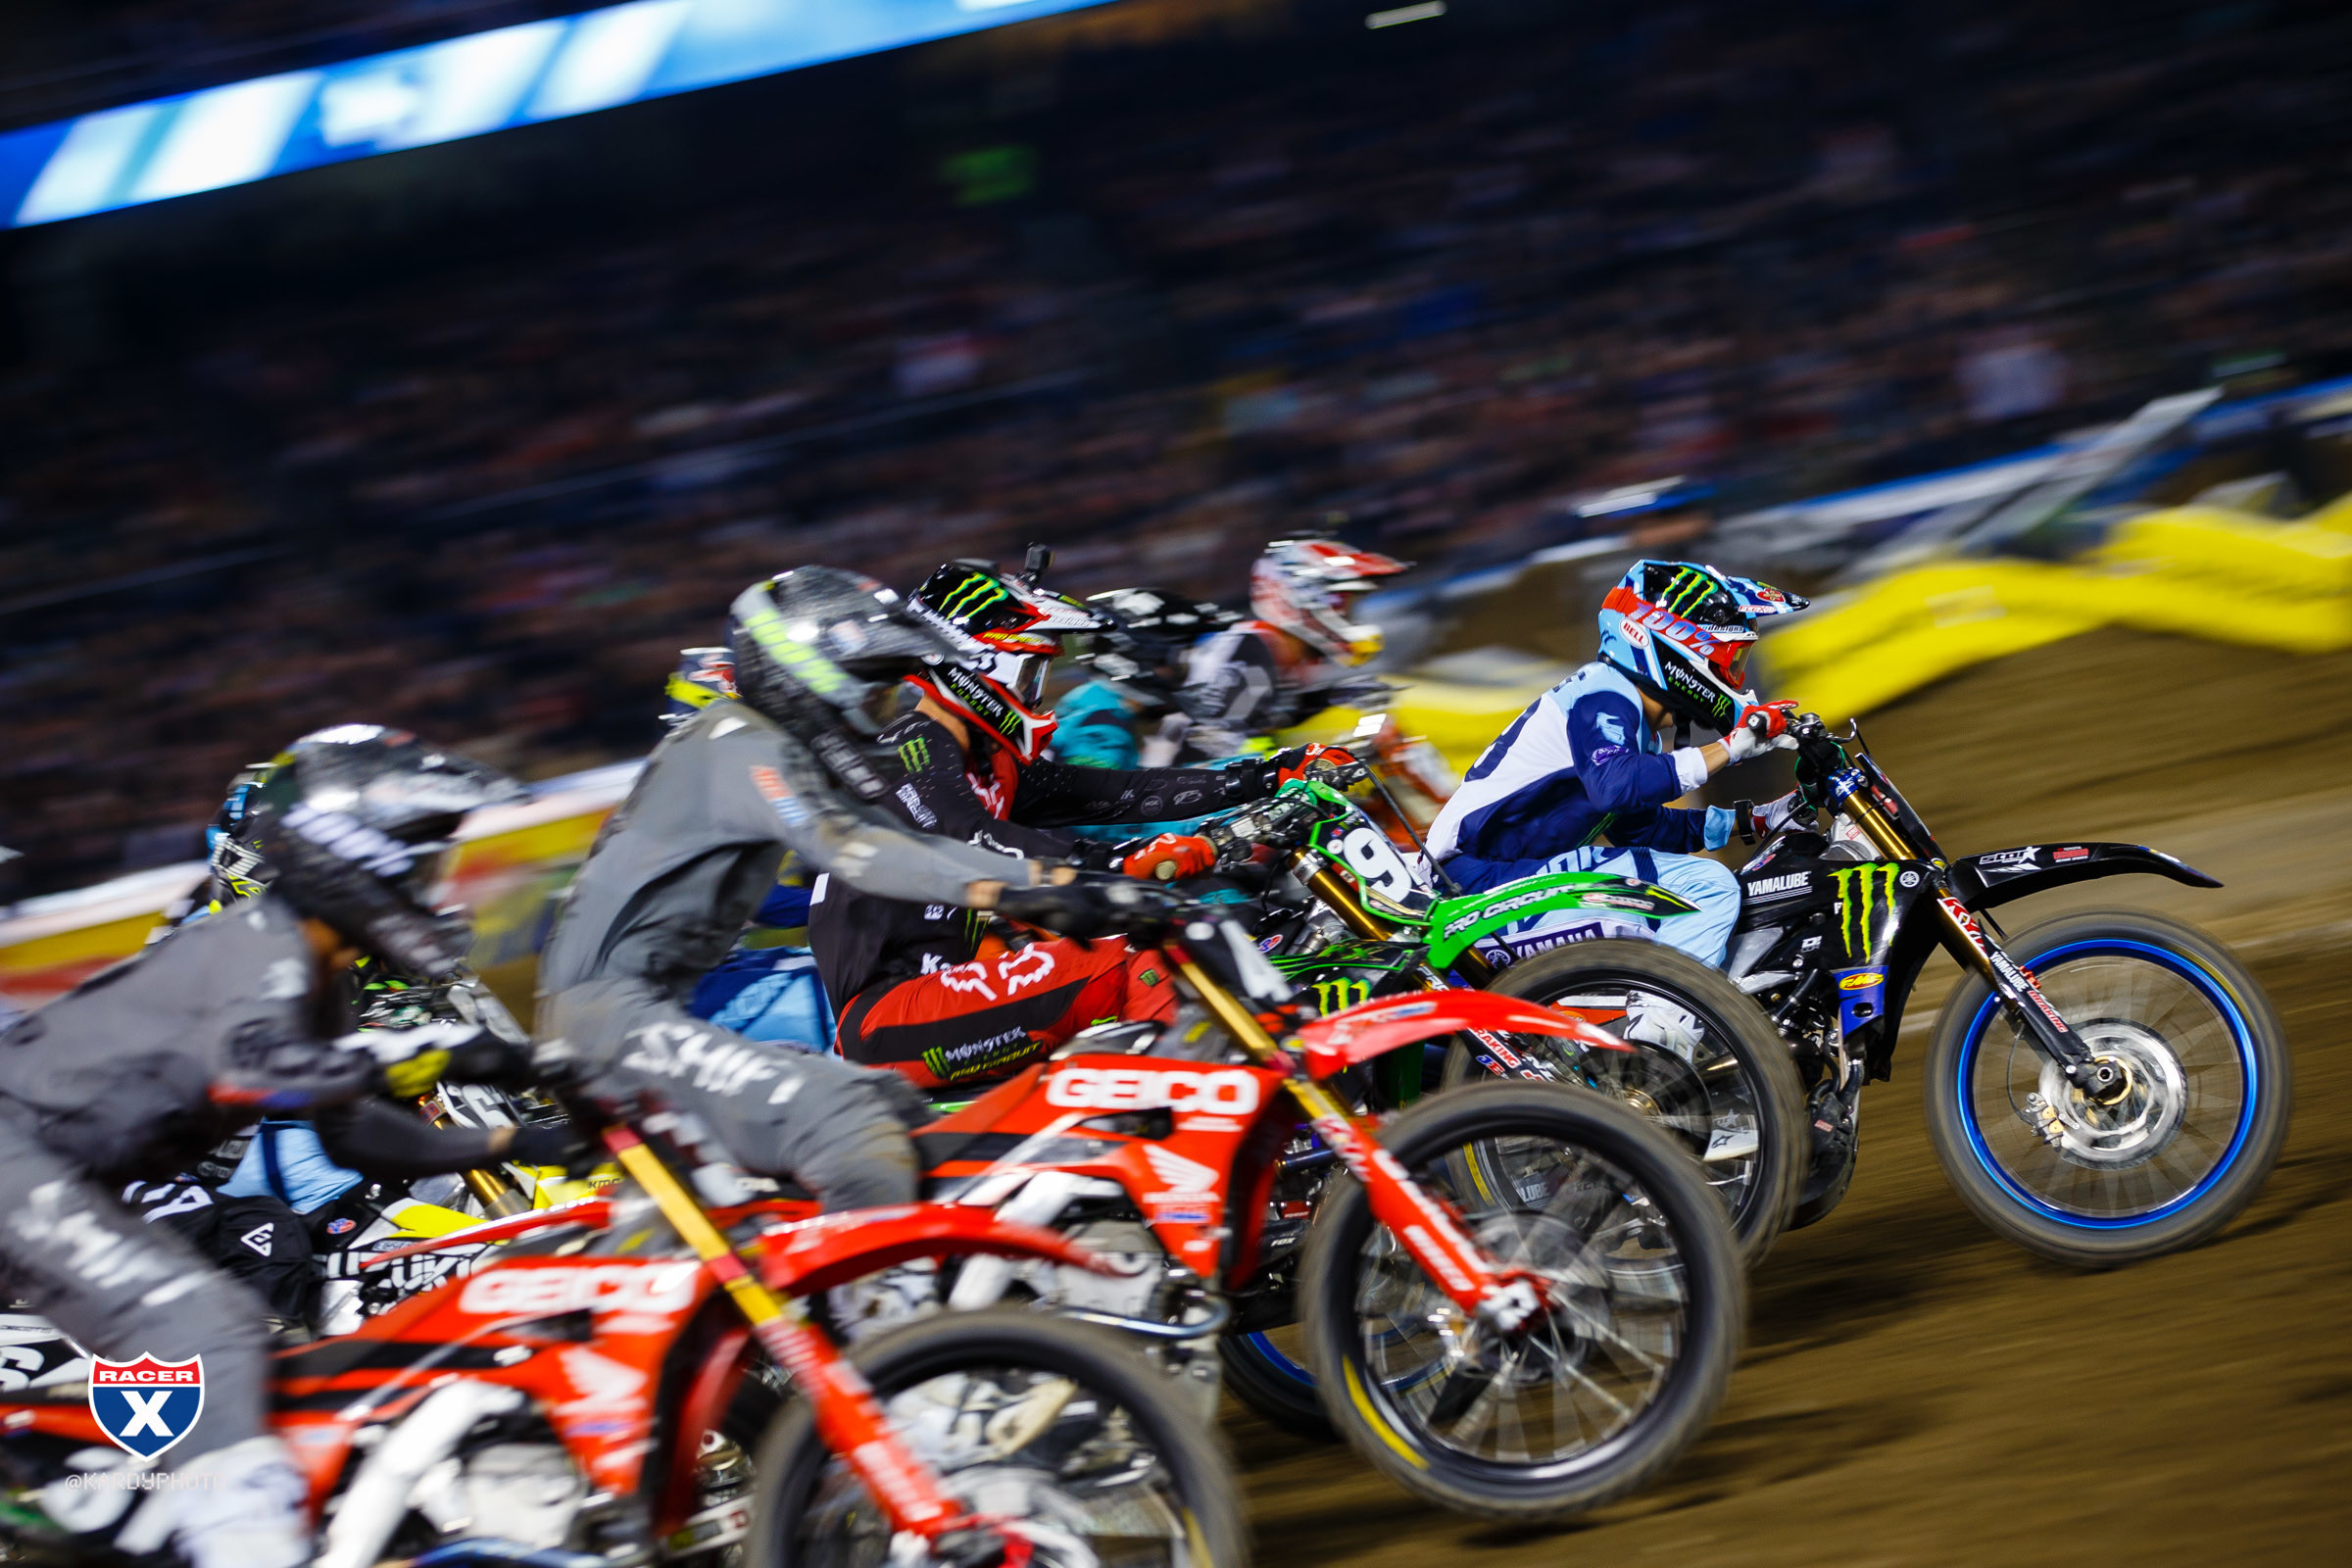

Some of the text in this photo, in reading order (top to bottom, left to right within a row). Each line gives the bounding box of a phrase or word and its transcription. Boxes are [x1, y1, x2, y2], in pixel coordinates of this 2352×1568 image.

[1623, 622, 1643, 645] BELL
[1626, 602, 1722, 656] 100%
[1664, 661, 1716, 704] MONSTER
[1344, 827, 1412, 903] 9
[1747, 871, 1811, 897] YAMALUBE
[1443, 910, 1481, 942] PRO
[1989, 951, 2030, 992] YAMALUBE
[1475, 1028, 1519, 1068] RAKING
[1046, 1067, 1260, 1114] GEICO
